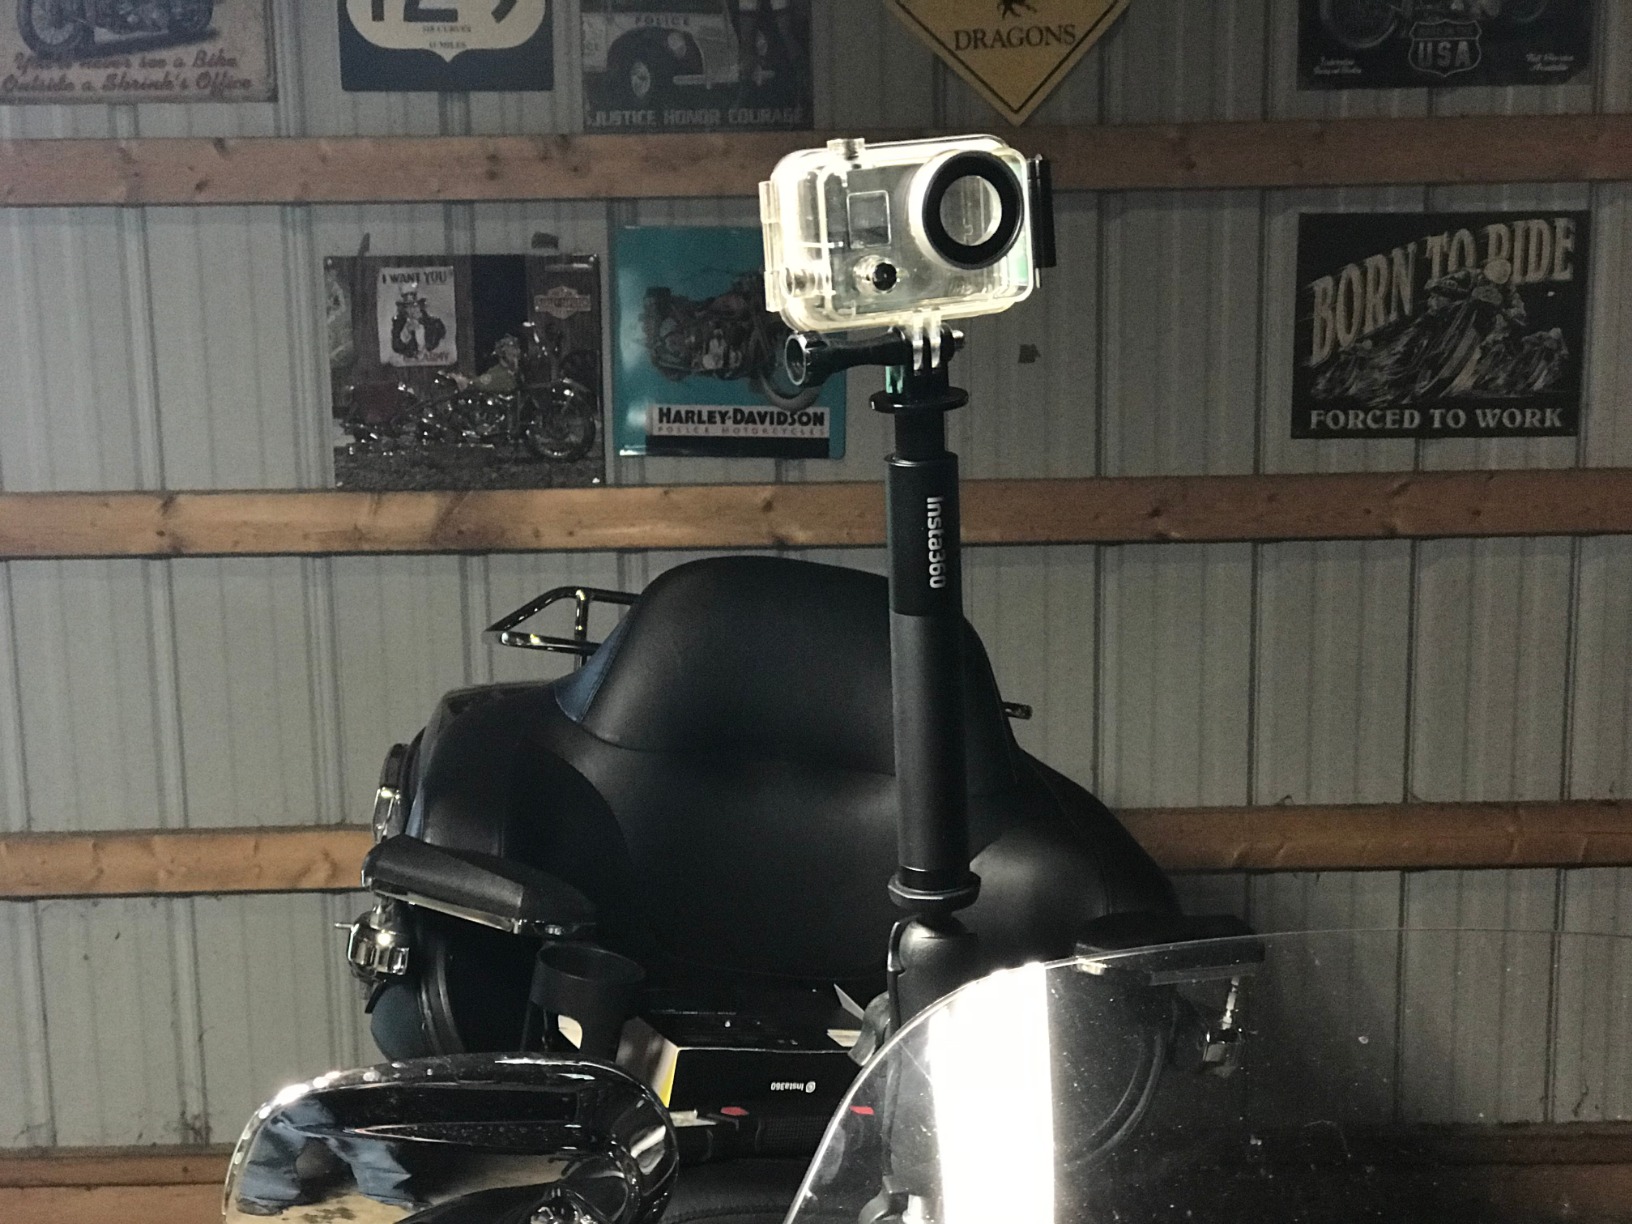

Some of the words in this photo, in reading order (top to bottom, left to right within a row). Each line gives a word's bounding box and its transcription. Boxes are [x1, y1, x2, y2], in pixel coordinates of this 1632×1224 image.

[635, 15, 690, 26] POLICE
[953, 24, 1076, 51] DRAGONS
[1418, 41, 1471, 67] USA
[173, 57, 185, 69] a
[81, 80, 97, 92] a
[593, 109, 656, 126] JUSTICE
[663, 109, 721, 126] HONOR
[389, 271, 420, 284] WANT
[424, 270, 447, 285] YOU
[1308, 241, 1417, 367] BORN
[1425, 228, 1477, 282] TO
[1485, 217, 1577, 285] RIDE
[657, 406, 825, 427] HARLEY-DAVIDSON
[1309, 408, 1421, 430] FORCED
[1429, 408, 1467, 429] TO
[1475, 407, 1564, 429] WORK
[721, 427, 825, 436] MOTORCYCLES
[926, 496, 947, 589] Insta360
[770, 1081, 804, 1091] Insta360
